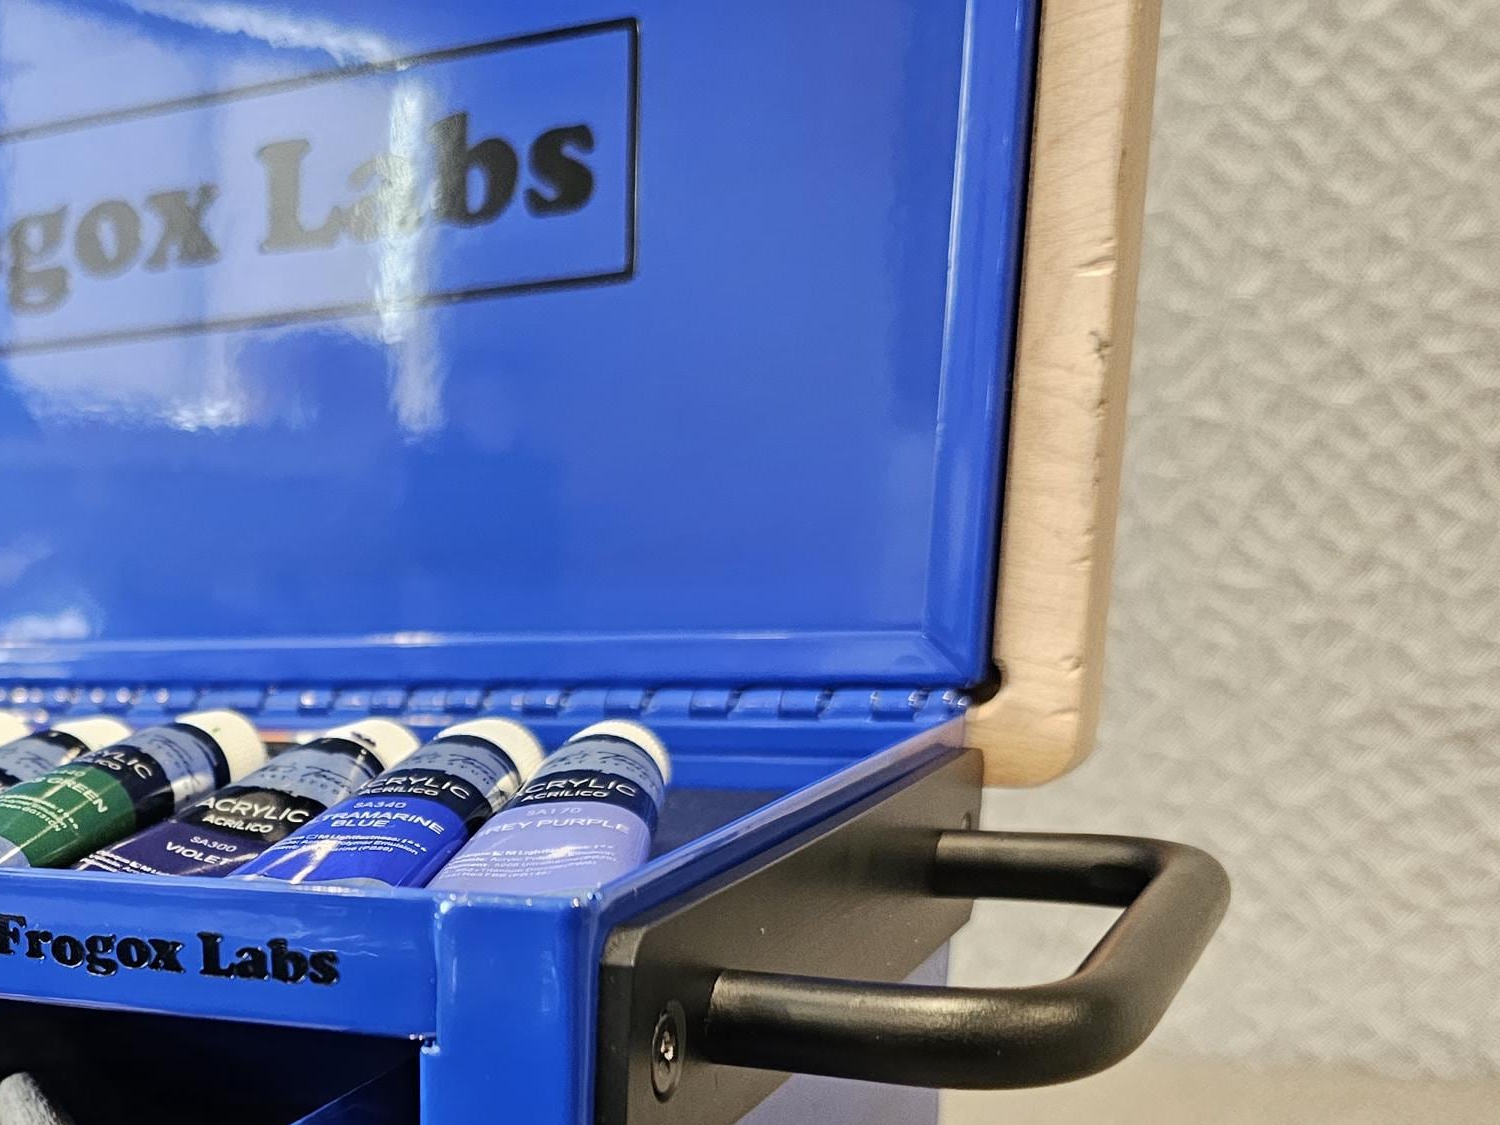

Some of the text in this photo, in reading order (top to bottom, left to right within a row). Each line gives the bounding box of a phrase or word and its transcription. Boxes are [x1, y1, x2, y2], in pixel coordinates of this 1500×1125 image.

[253, 112, 596, 256] Labs
[47, 777, 109, 814] GREEN
[195, 796, 310, 824] ACRYLIC
[310, 809, 445, 835] TRAMARINE
[330, 818, 390, 829] BLUE
[536, 817, 631, 835] PURPLE
[165, 842, 235, 866] VIOLET
[189, 836, 238, 853] SA300
[196, 931, 341, 986] Labs
